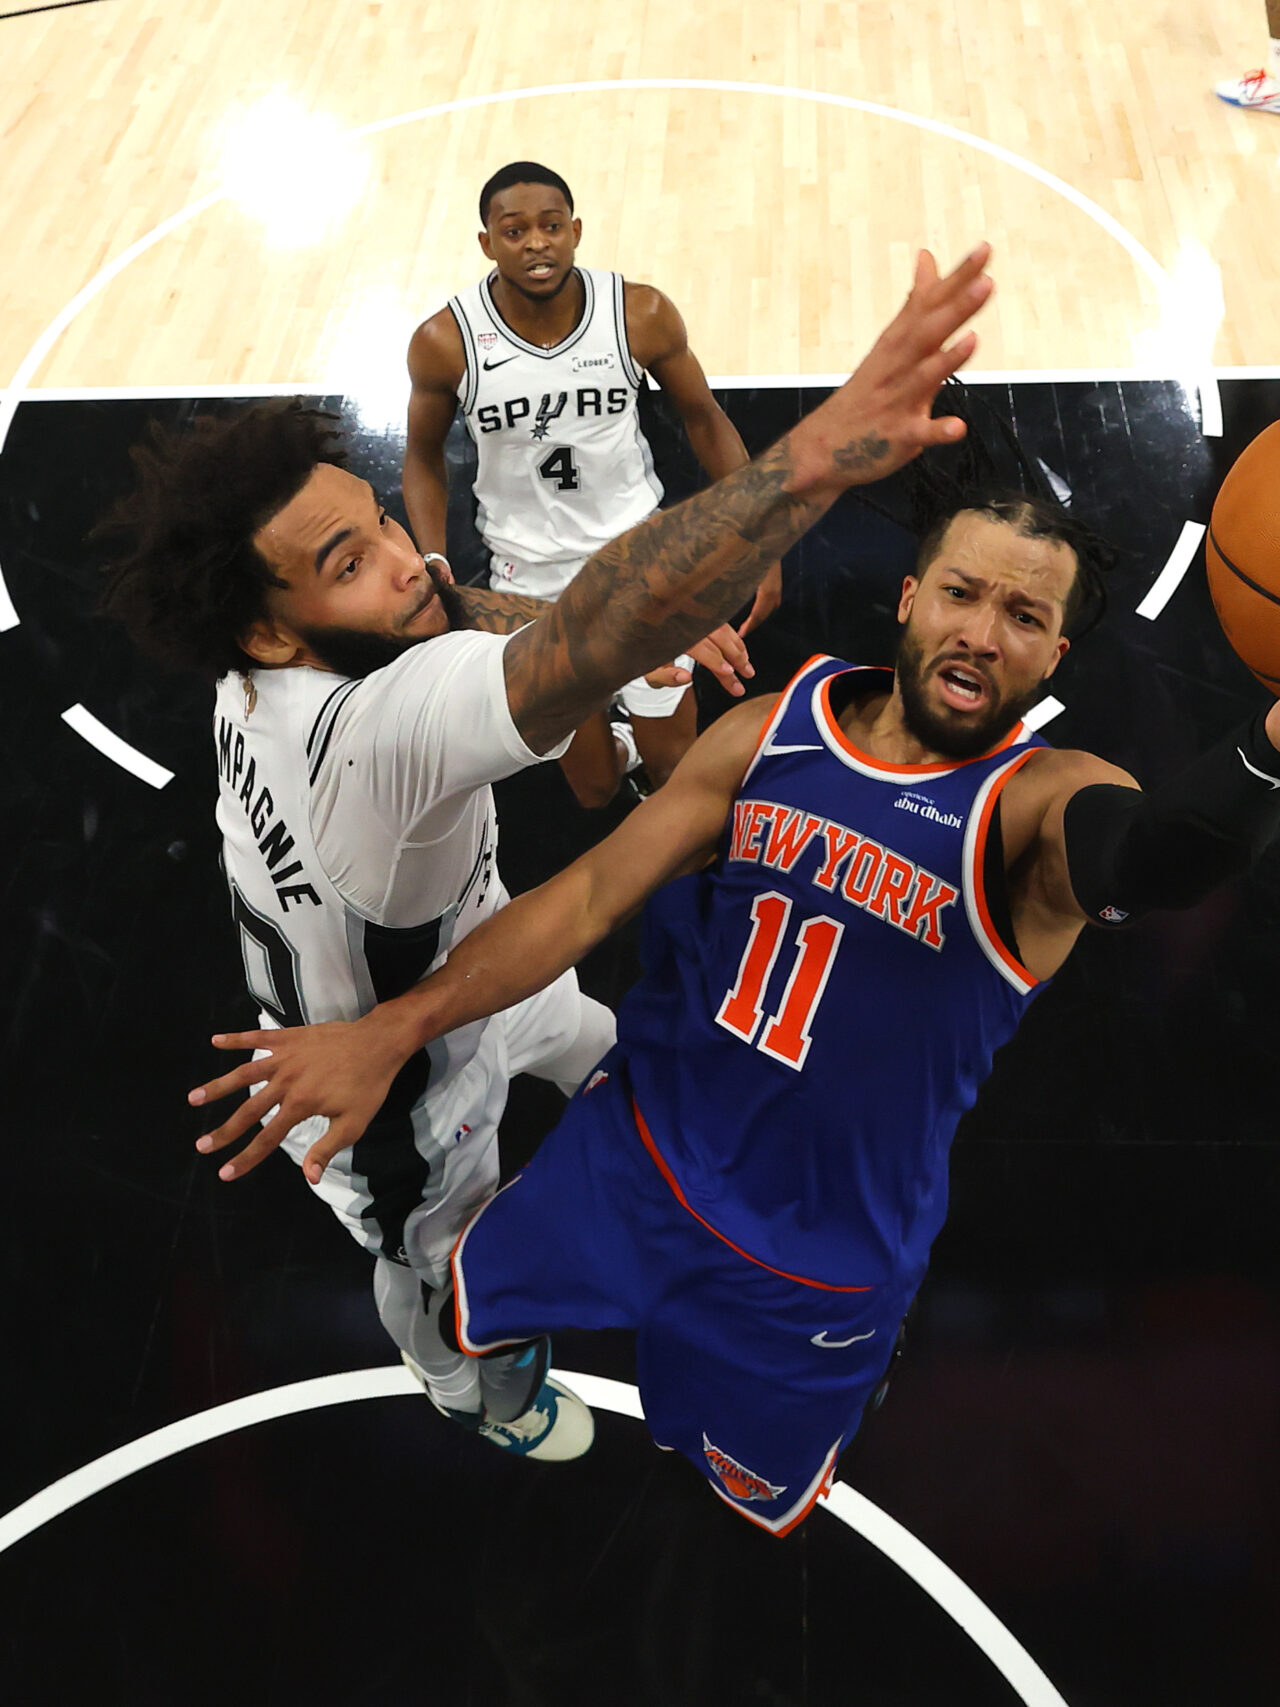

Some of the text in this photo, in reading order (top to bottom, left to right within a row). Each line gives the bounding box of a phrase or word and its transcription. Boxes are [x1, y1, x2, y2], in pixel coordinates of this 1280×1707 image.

[577, 357, 610, 368] LEDGER
[477, 388, 628, 441] SPURS
[537, 445, 581, 493] 4
[216, 715, 323, 913] MPAGNIE
[894, 797, 964, 829] abu dhabi
[729, 799, 961, 952] NEW YORK
[714, 890, 845, 1072] 11
